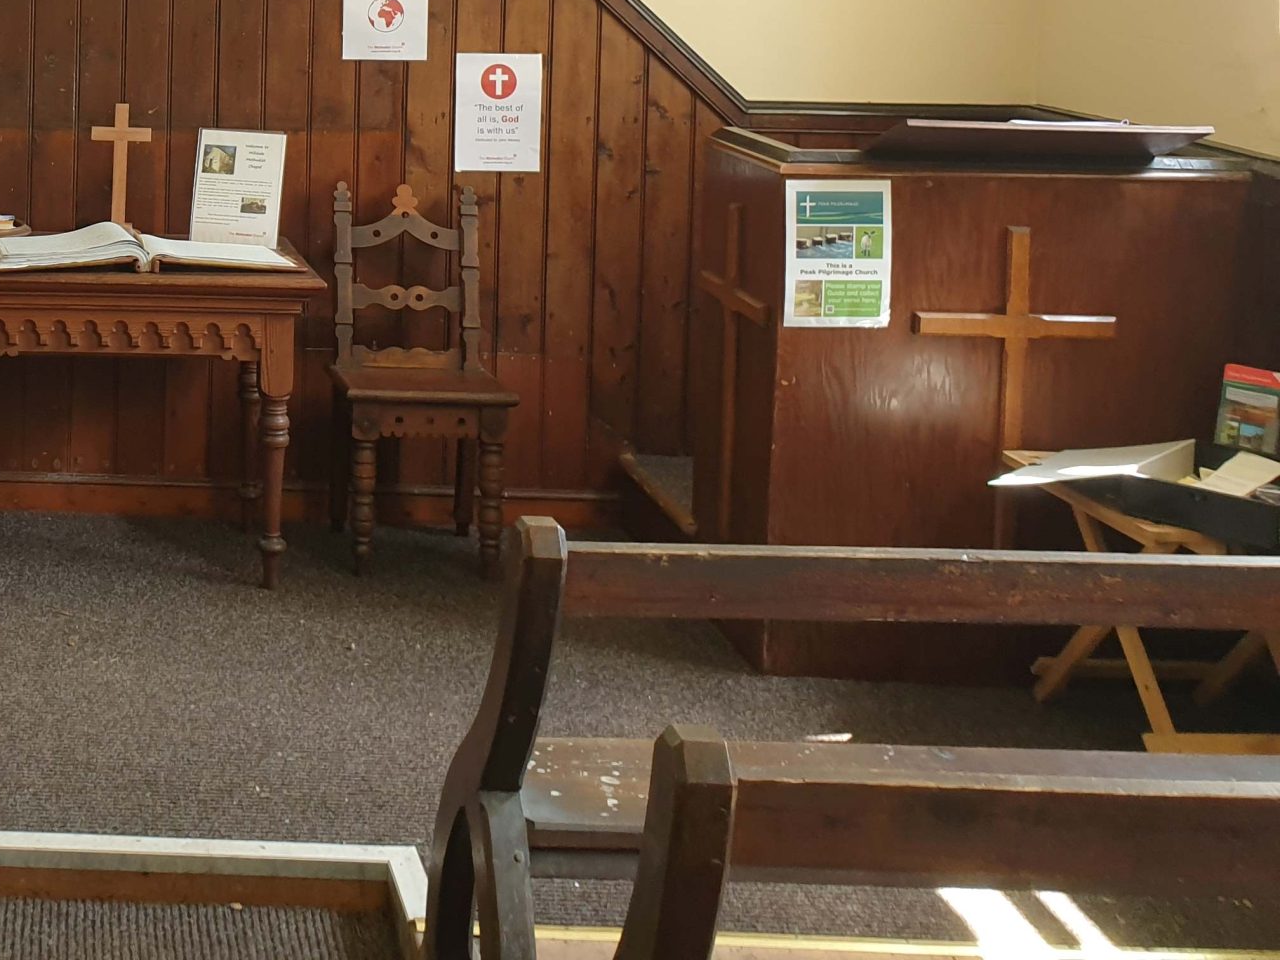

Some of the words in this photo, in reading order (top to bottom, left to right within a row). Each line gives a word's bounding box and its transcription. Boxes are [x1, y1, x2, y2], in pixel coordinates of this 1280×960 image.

[494, 104, 513, 112] best
[515, 104, 524, 112] of
[476, 115, 487, 123] all
[489, 115, 499, 124] is,
[501, 115, 519, 123] God
[476, 126, 484, 134] is
[486, 126, 504, 134] with
